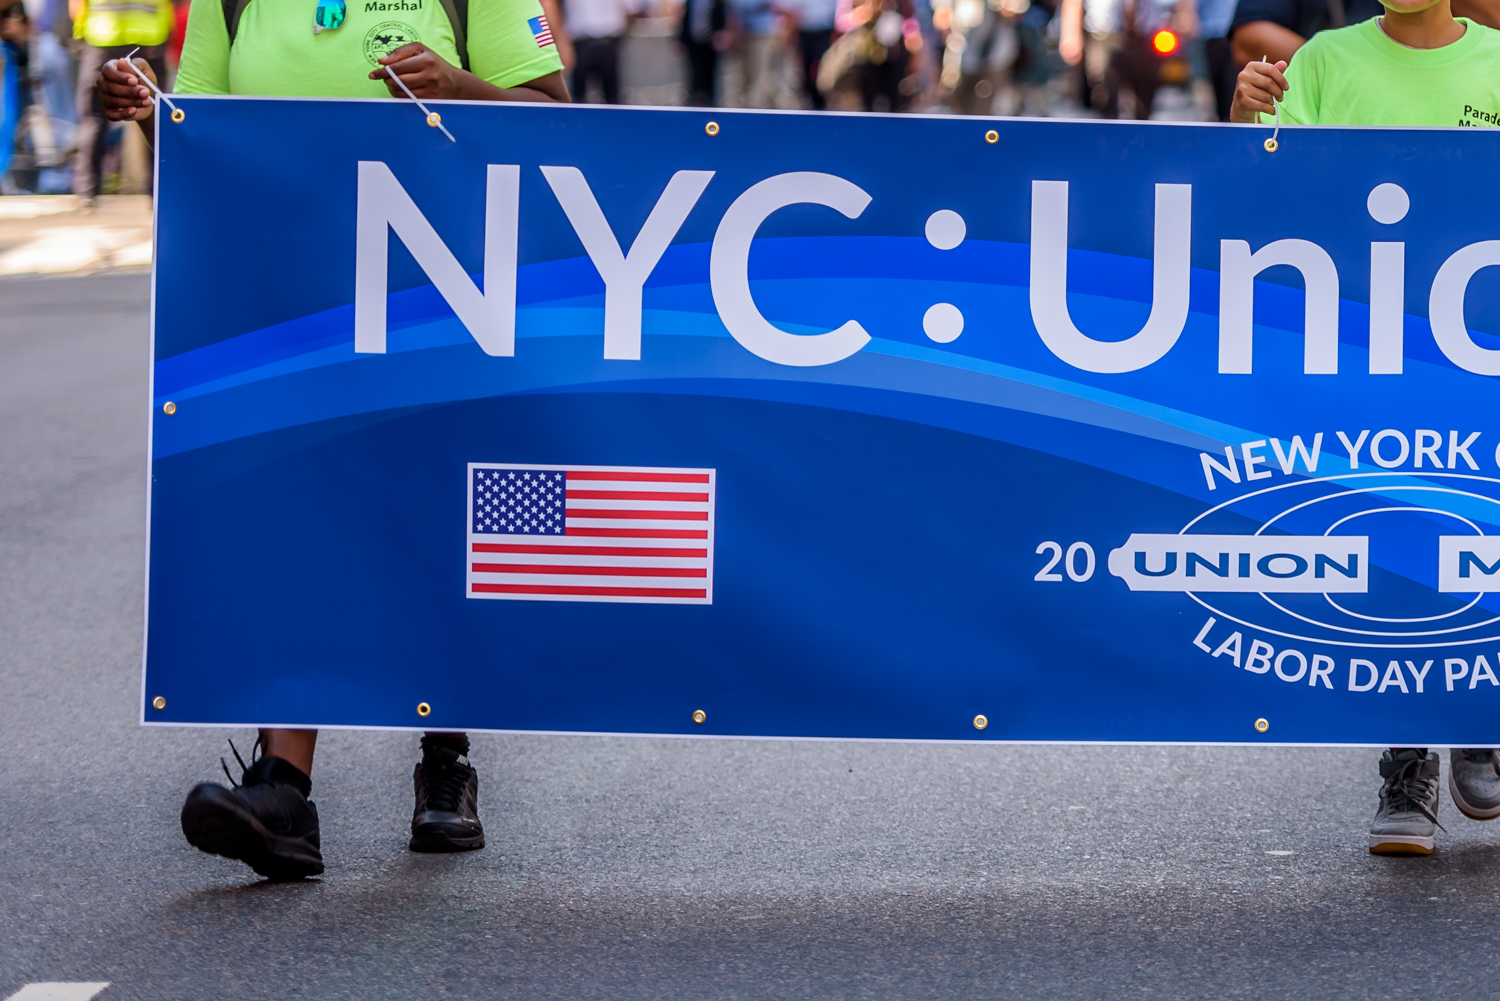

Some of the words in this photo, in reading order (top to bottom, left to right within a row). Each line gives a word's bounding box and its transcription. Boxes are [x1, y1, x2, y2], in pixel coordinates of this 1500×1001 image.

[364, 0, 422, 12] Marshal
[1199, 432, 1324, 491] NEW
[1335, 428, 1482, 471] YORK
[1033, 540, 1096, 583] 20
[1133, 551, 1359, 579] UNION
[1192, 616, 1336, 690] LABOR
[1347, 658, 1434, 694] DAY
